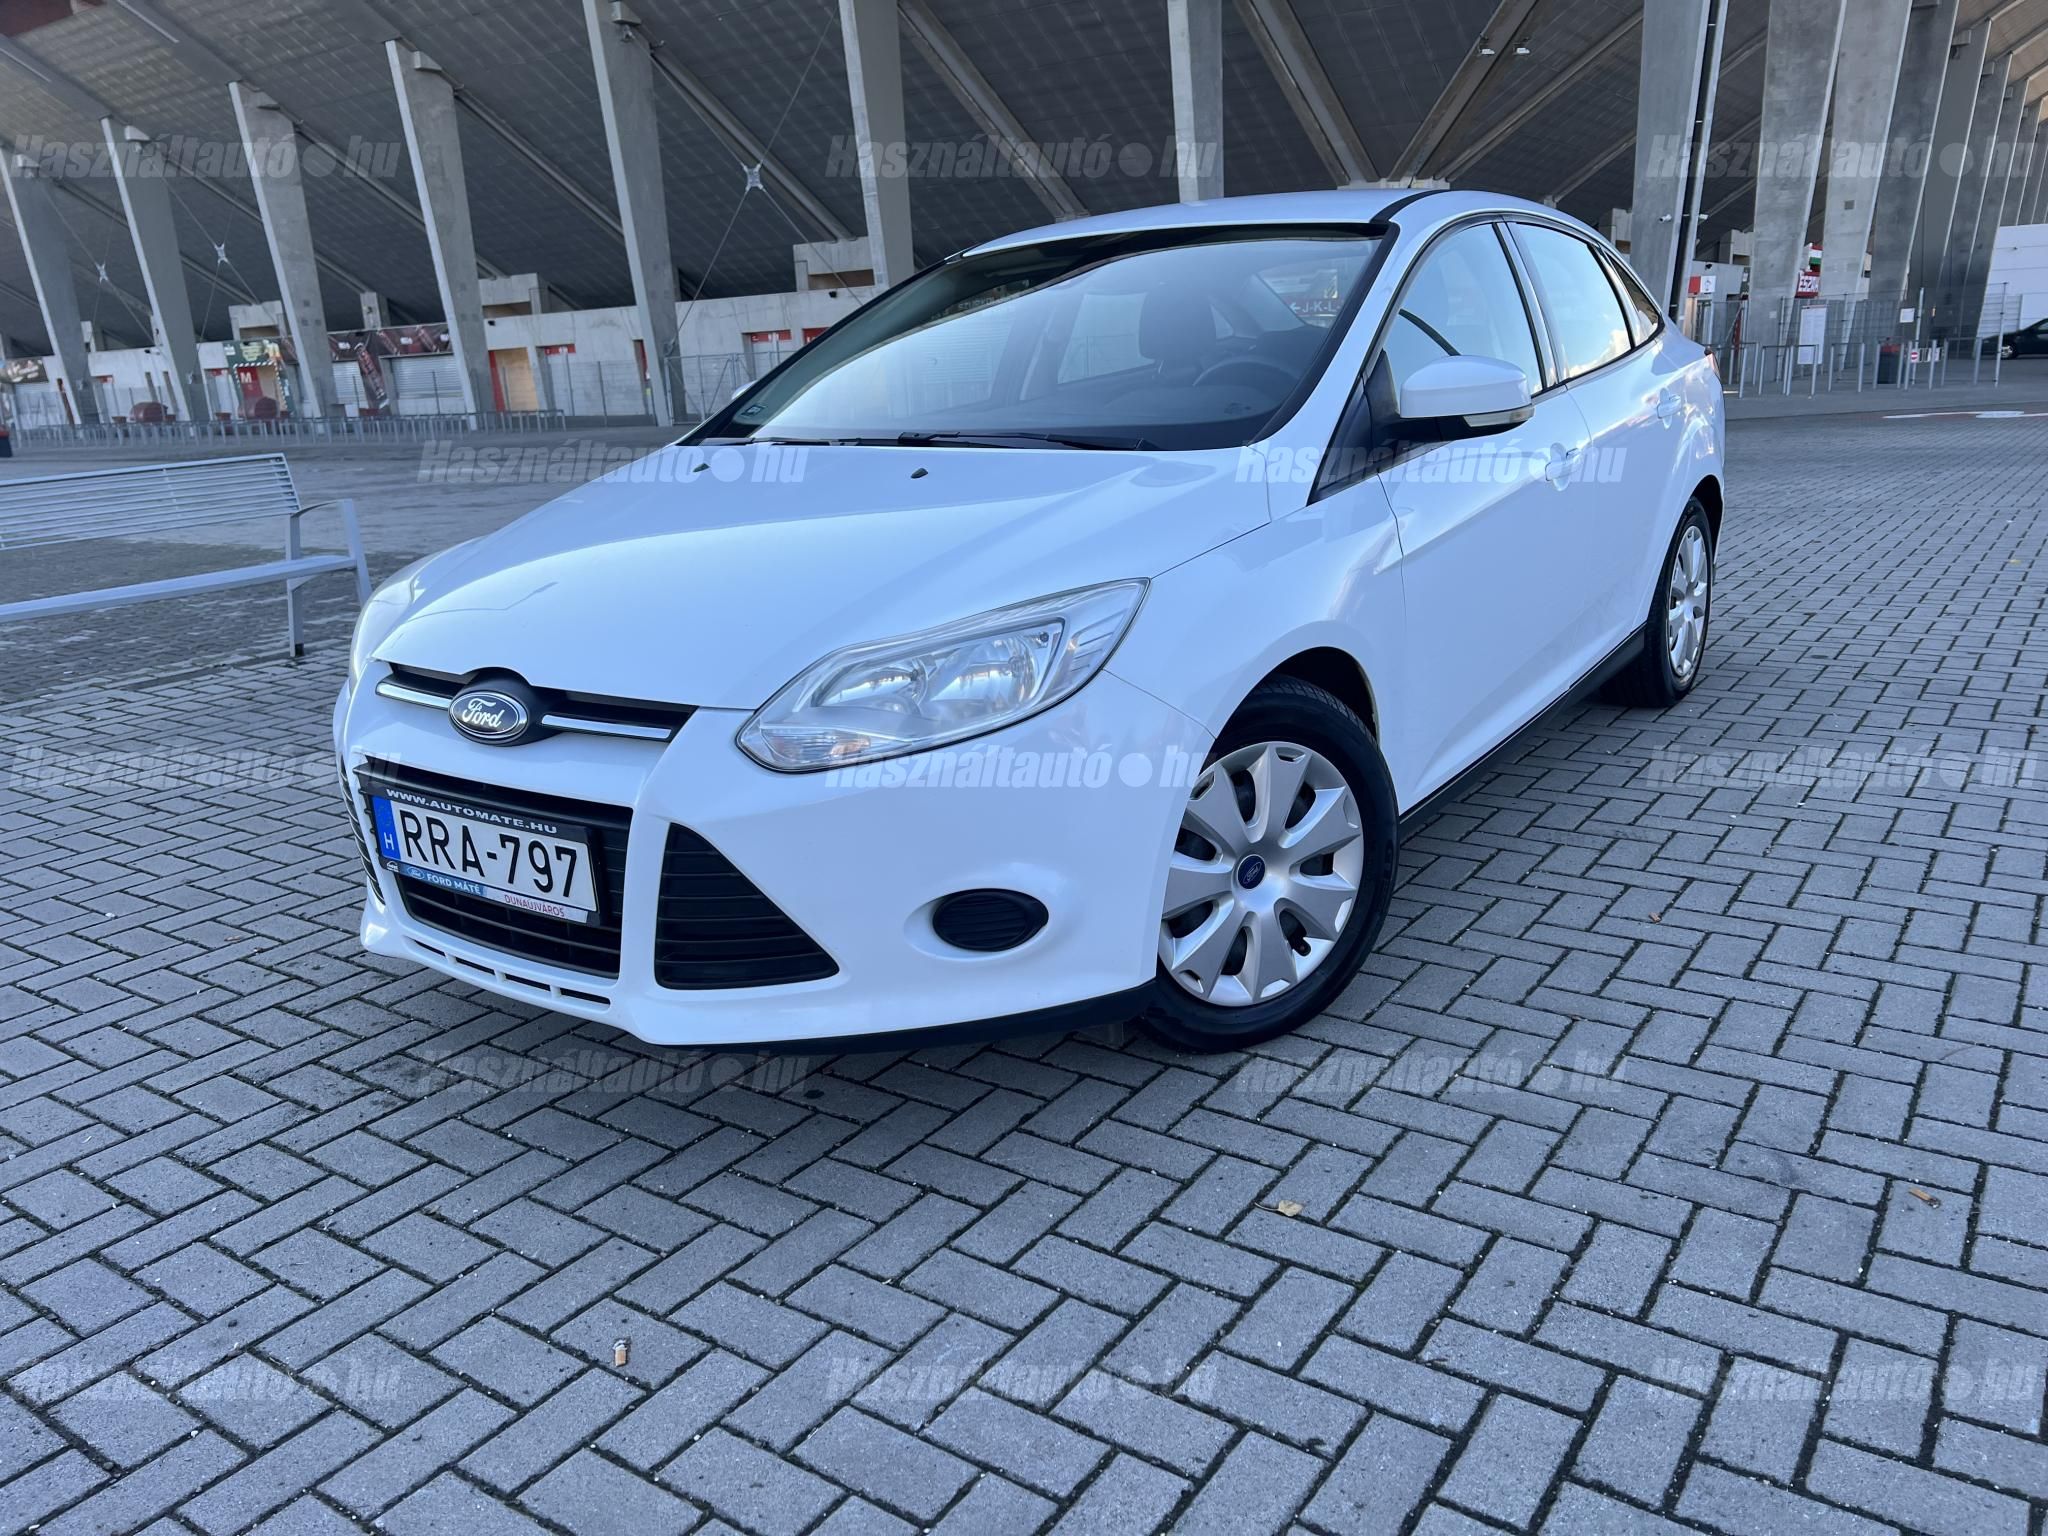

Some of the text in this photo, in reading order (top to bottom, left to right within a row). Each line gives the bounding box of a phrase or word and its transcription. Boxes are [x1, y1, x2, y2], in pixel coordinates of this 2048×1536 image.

[461, 699, 504, 729] Ford
[386, 789, 557, 833] WWW.AUTOMATE.HU
[384, 832, 394, 851] H
[400, 809, 577, 897] RRA-797
[426, 873, 481, 895] FORD MÁTÉ
